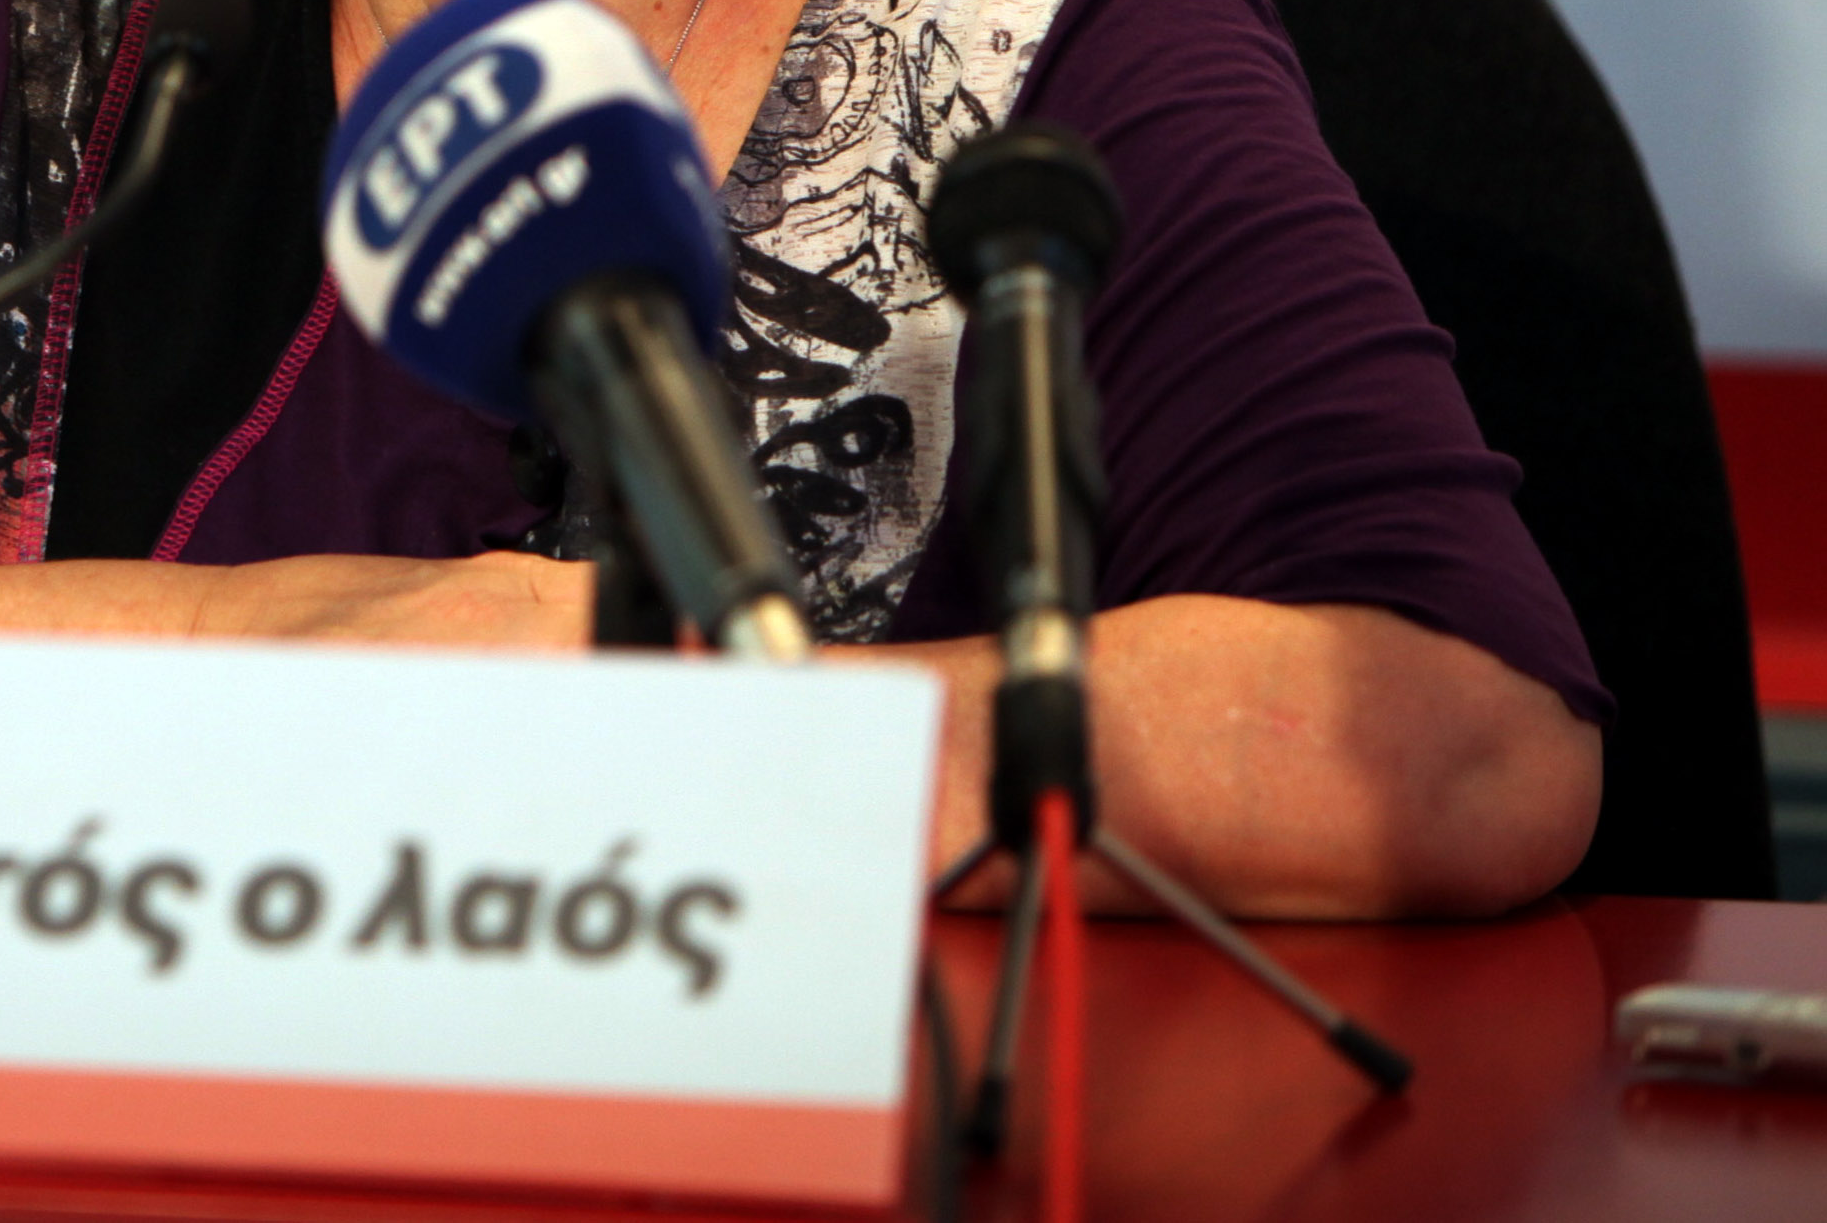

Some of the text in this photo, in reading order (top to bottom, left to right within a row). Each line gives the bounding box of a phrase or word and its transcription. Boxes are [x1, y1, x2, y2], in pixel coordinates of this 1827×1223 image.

[364, 52, 508, 226] ΕΡΤ
[235, 862, 325, 948] ο
[349, 833, 742, 1000] λαός
